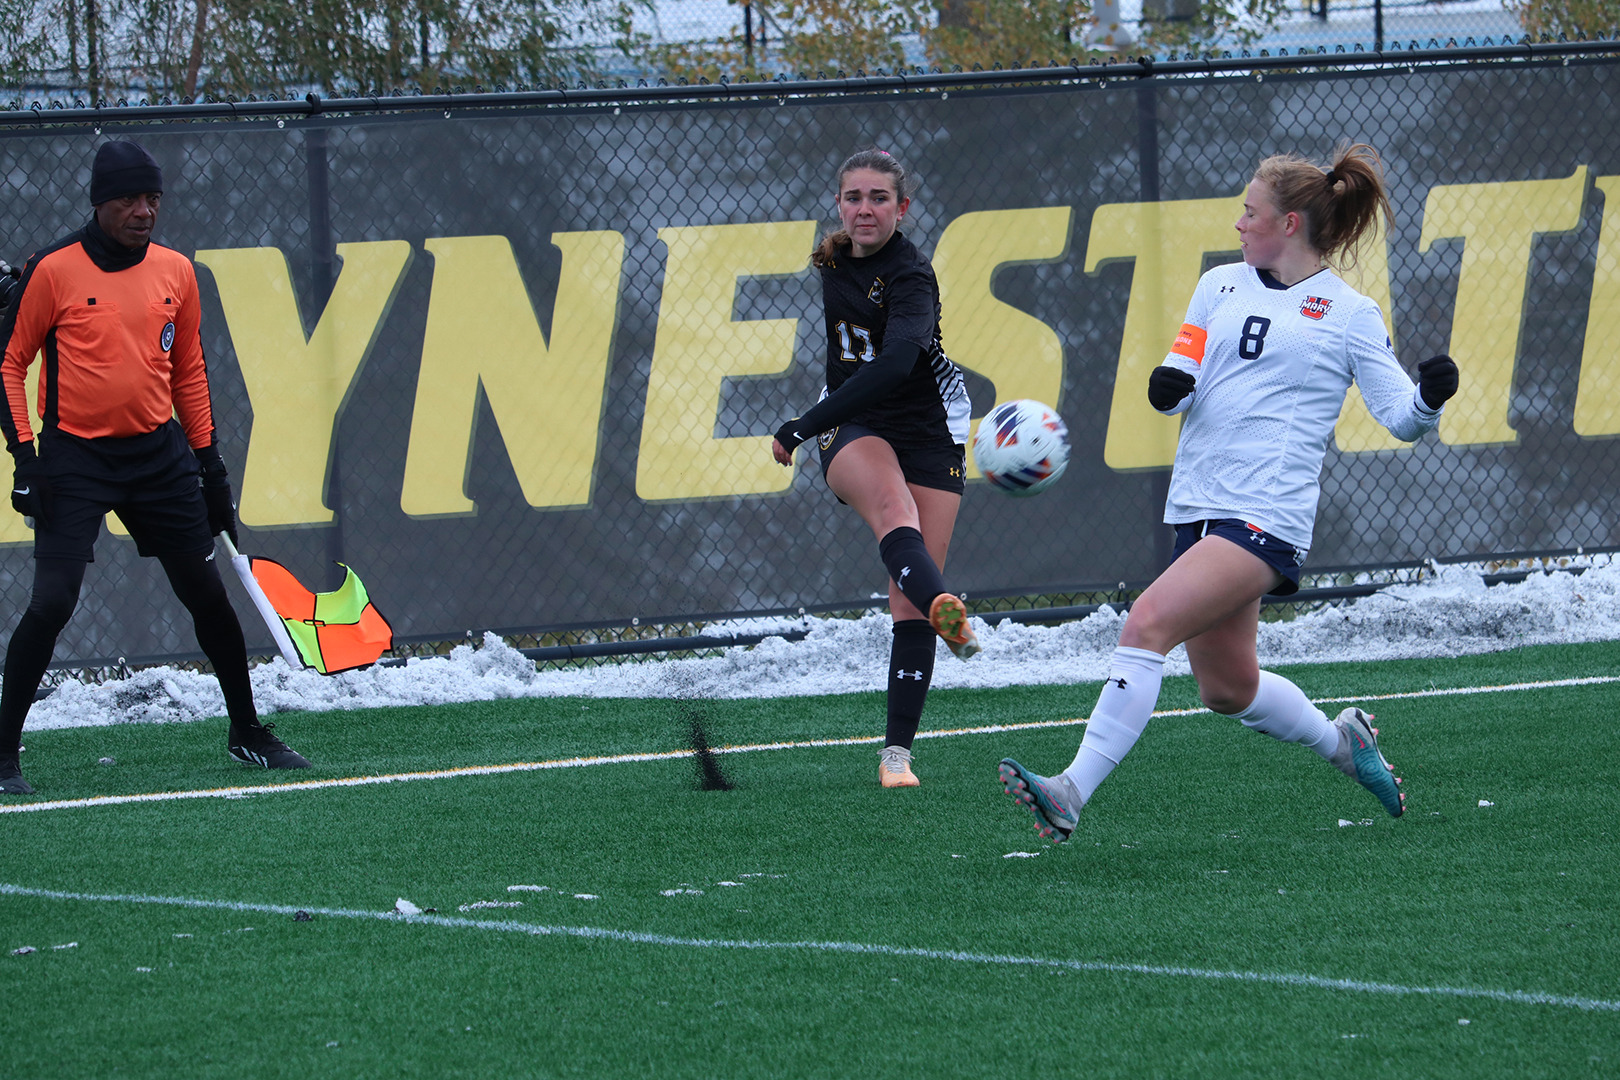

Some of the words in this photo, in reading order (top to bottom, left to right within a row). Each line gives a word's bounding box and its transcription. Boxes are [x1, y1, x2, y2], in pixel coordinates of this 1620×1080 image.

[1299, 299, 1333, 315] MARY
[835, 320, 876, 362] 17
[1238, 315, 1271, 360] 8
[0, 219, 824, 546] YNE
